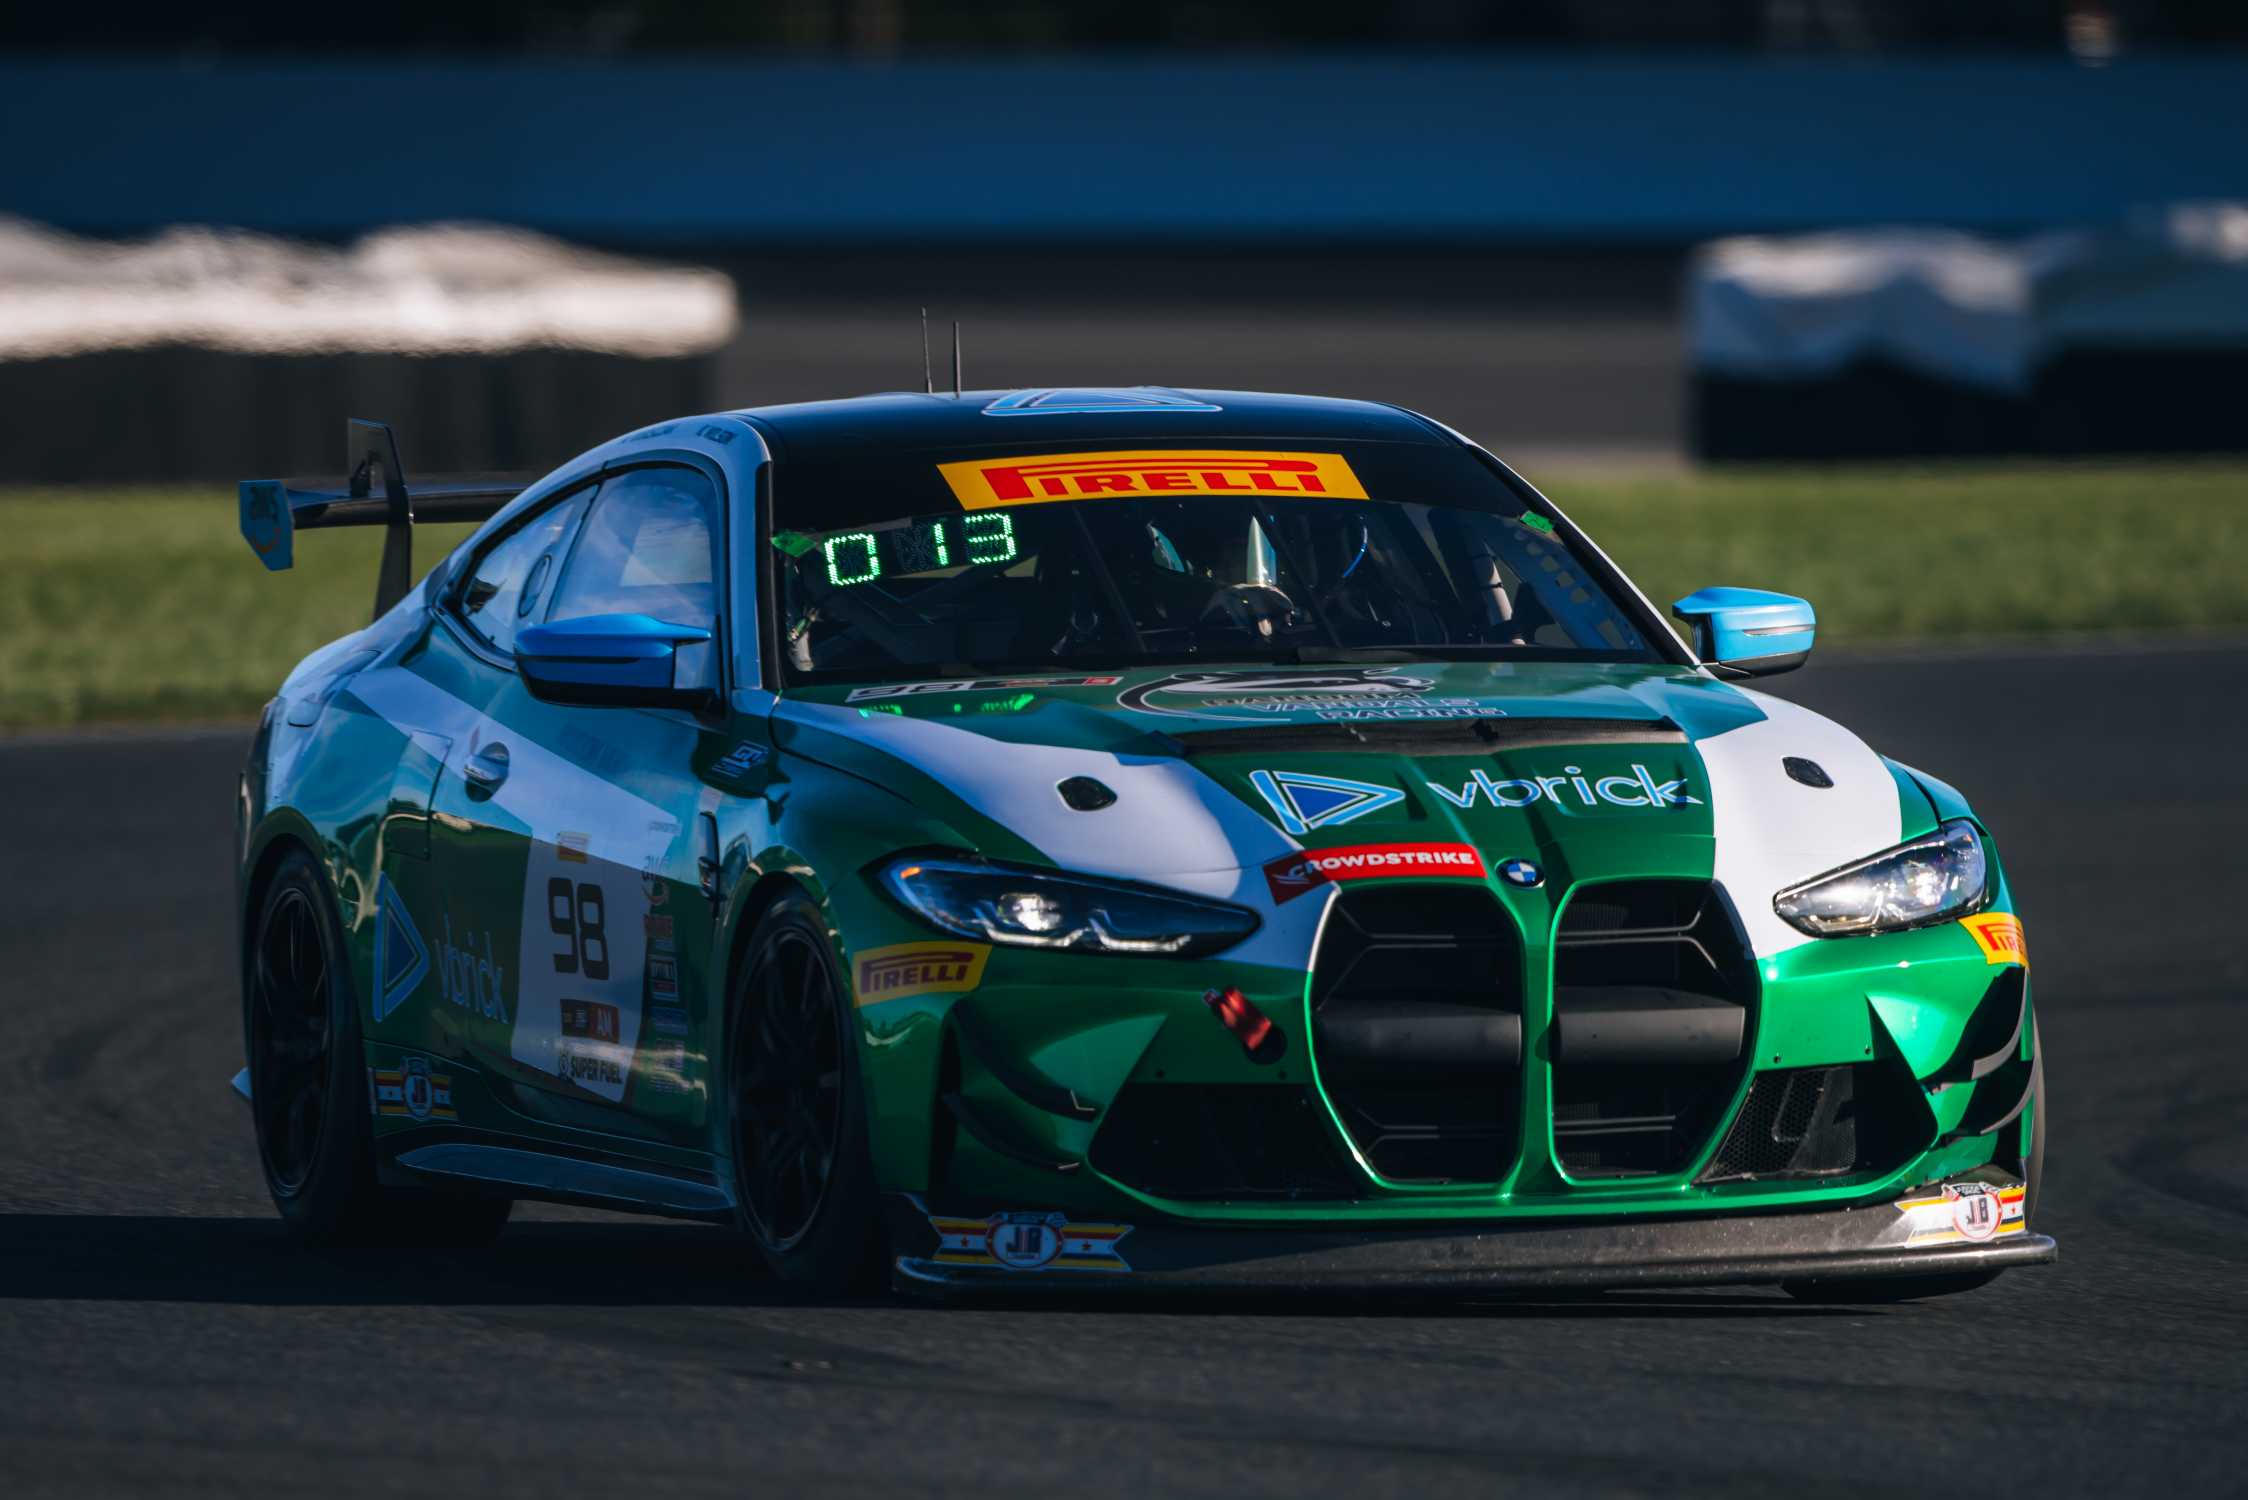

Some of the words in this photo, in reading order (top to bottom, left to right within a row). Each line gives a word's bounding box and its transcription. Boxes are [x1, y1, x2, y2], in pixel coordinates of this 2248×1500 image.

[981, 457, 1326, 500] PIRELLI
[1426, 764, 1704, 808] vbrick
[548, 877, 609, 981] 98
[433, 911, 512, 1025] vbrick
[861, 952, 975, 994] PIRELLI
